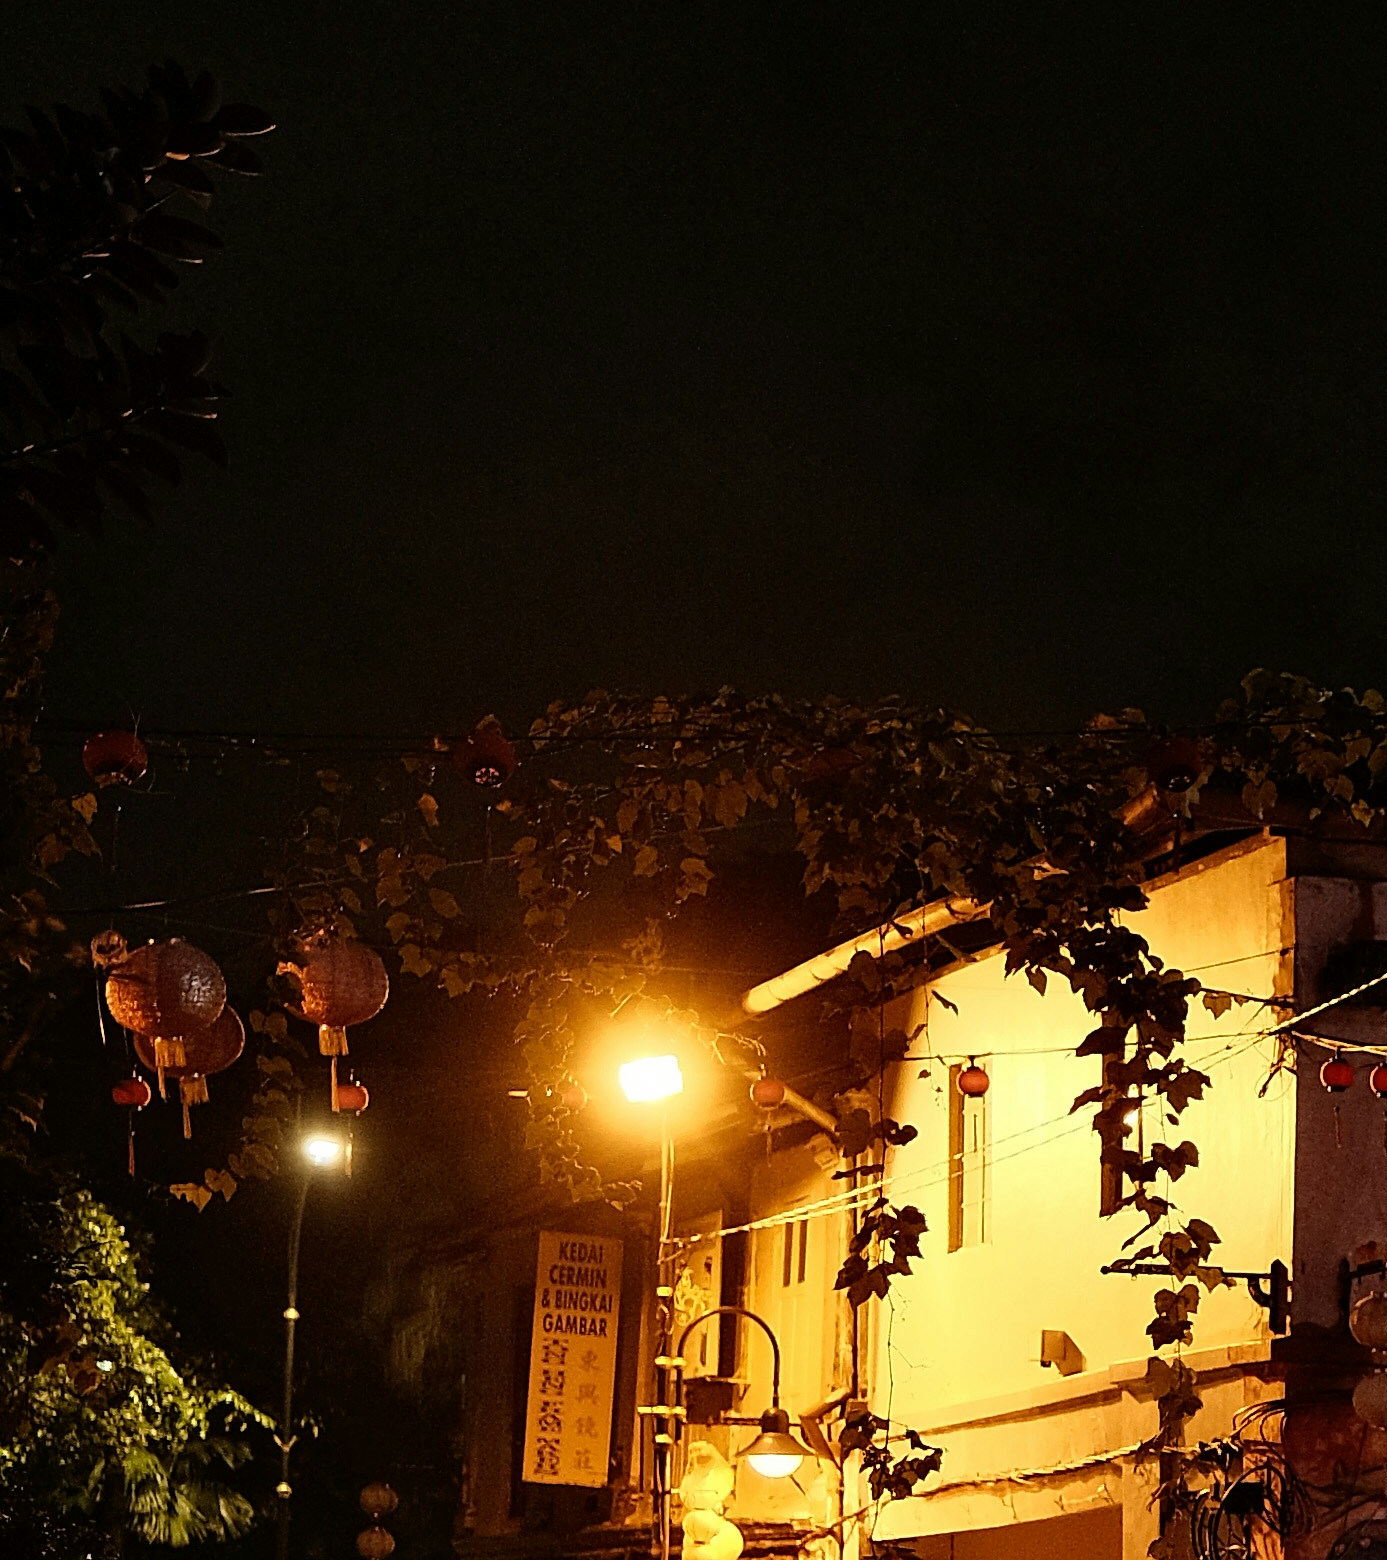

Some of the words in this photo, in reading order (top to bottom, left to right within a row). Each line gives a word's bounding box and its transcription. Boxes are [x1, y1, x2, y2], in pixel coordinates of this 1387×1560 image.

[559, 1241, 603, 1263] KEDAI
[549, 1264, 607, 1289] CERMIN
[541, 1288, 550, 1309] &
[555, 1289, 613, 1313] BINGKAI
[542, 1313, 607, 1337] GAMBAR
